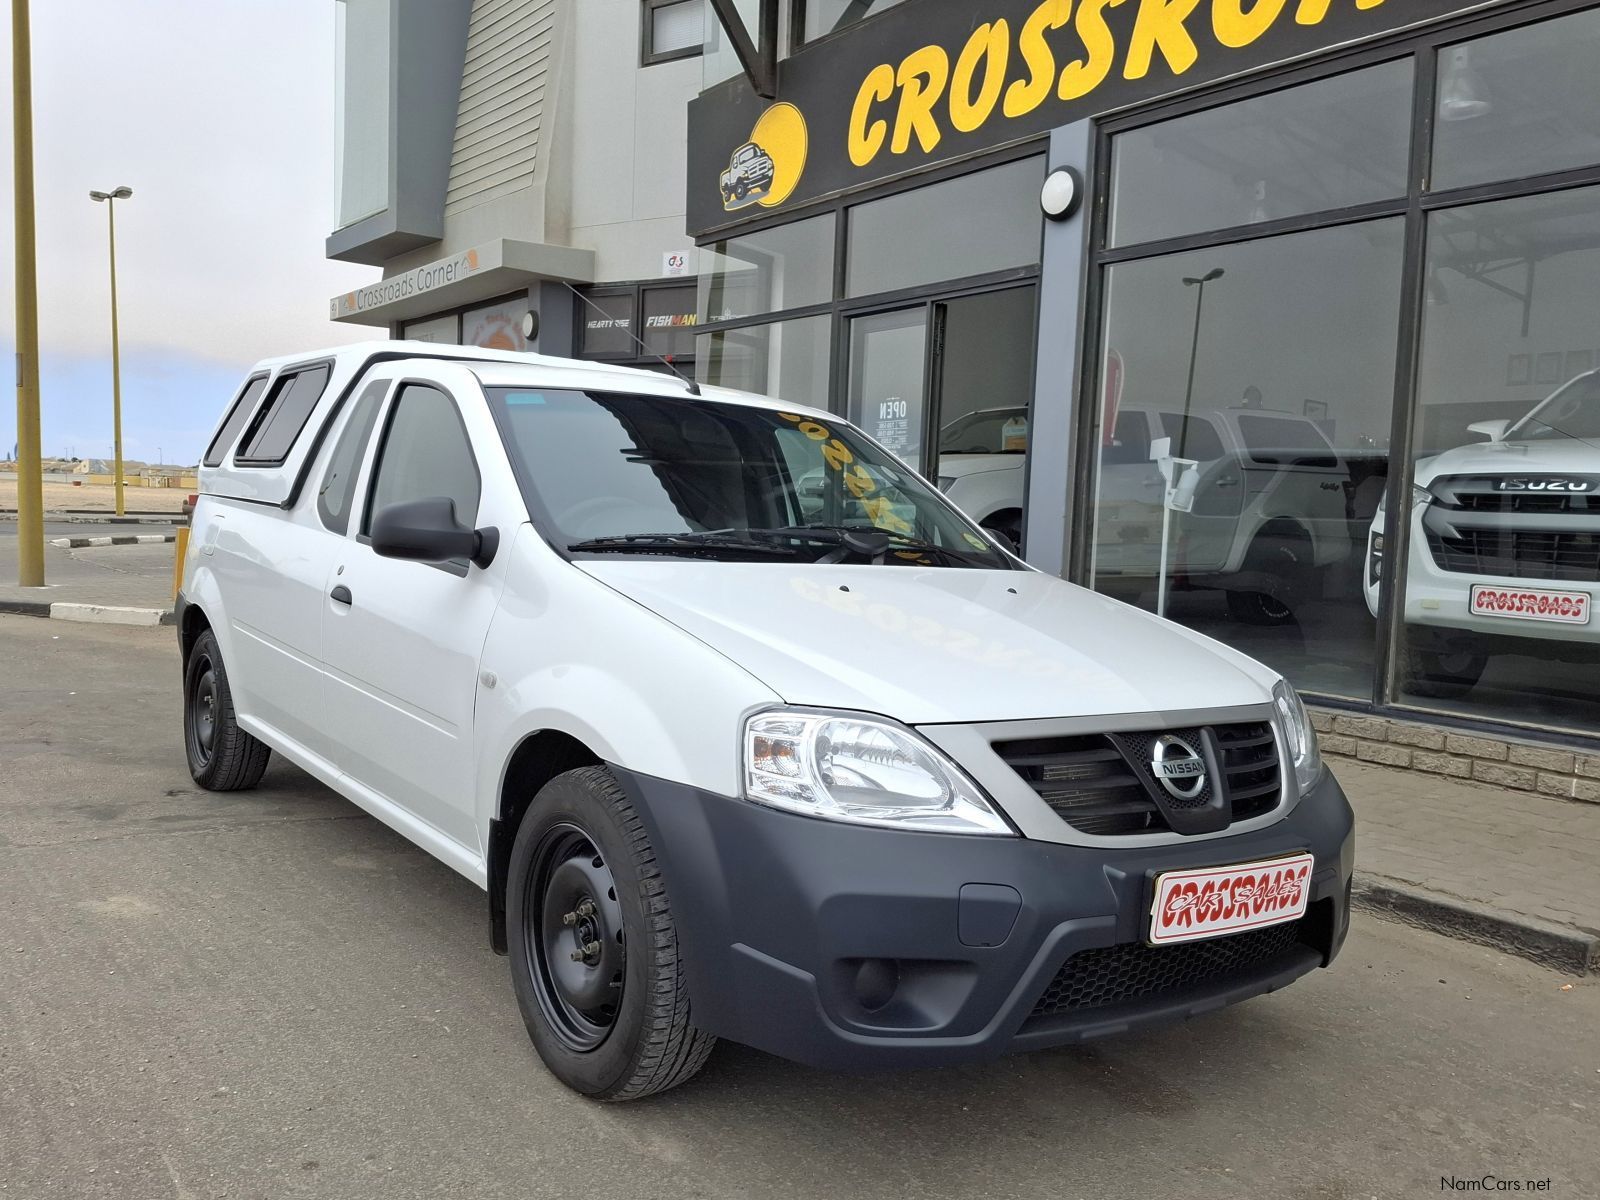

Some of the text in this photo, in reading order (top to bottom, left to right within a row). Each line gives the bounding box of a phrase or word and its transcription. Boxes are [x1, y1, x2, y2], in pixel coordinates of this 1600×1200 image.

[848, 0, 1386, 167] CROSSR
[357, 259, 459, 310] Crossroads Corner
[587, 319, 614, 329] HEARTY
[645, 313, 697, 328] FISHMAN
[1499, 478, 1588, 491] ISUZU
[1476, 590, 1585, 617] CROSSROADS
[1163, 761, 1205, 775] NISSAN
[1162, 865, 1308, 929] CROSSROADS
[1167, 879, 1303, 912] CAR SALES
